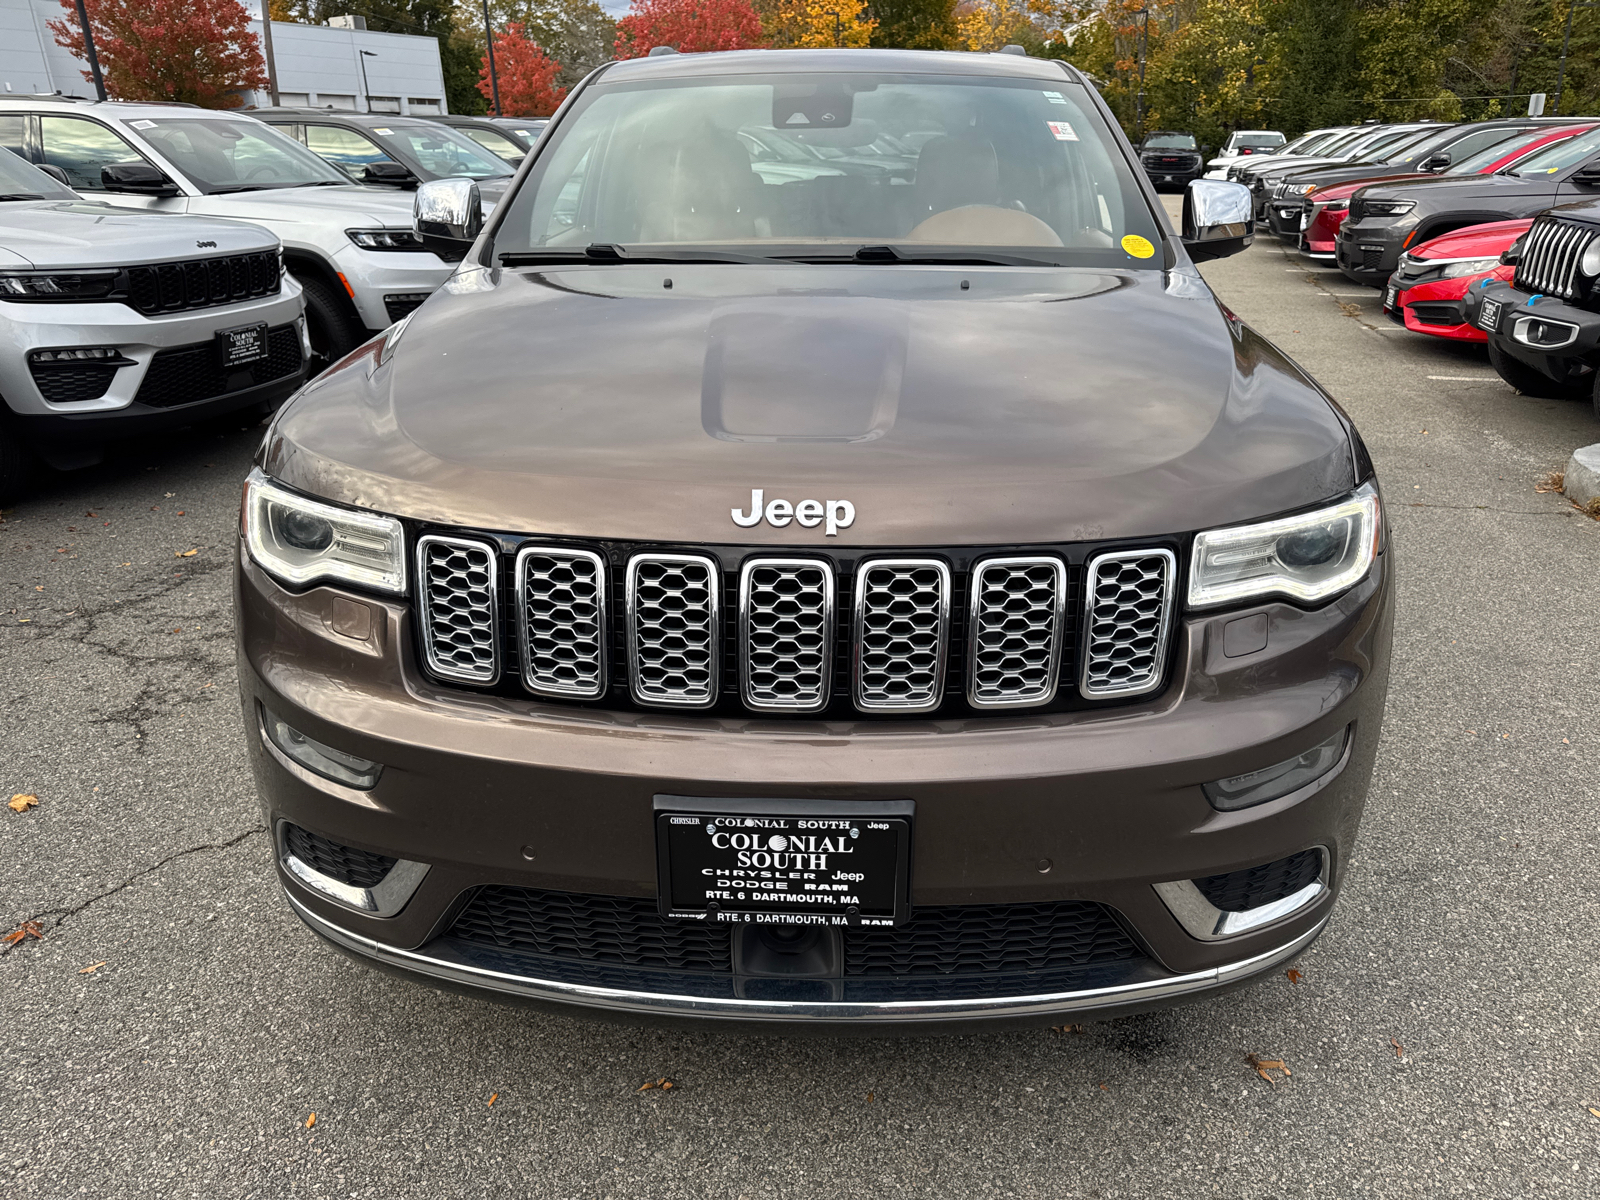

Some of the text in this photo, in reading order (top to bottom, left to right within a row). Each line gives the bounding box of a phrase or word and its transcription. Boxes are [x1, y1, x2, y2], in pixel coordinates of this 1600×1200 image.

[731, 488, 856, 537] Jeep
[669, 816, 701, 825] CHRYSLER
[797, 820, 851, 830] SOUTH
[867, 821, 890, 831] Jeep
[737, 850, 829, 871] SOUTH
[701, 868, 865, 883] CHRYSLER Jeep
[717, 879, 849, 891] DODGE RAM
[705, 890, 860, 905] RTE. 6 DARTMOUTH, MA
[717, 912, 849, 926] RTE. 6 DARTMOUTH, MA
